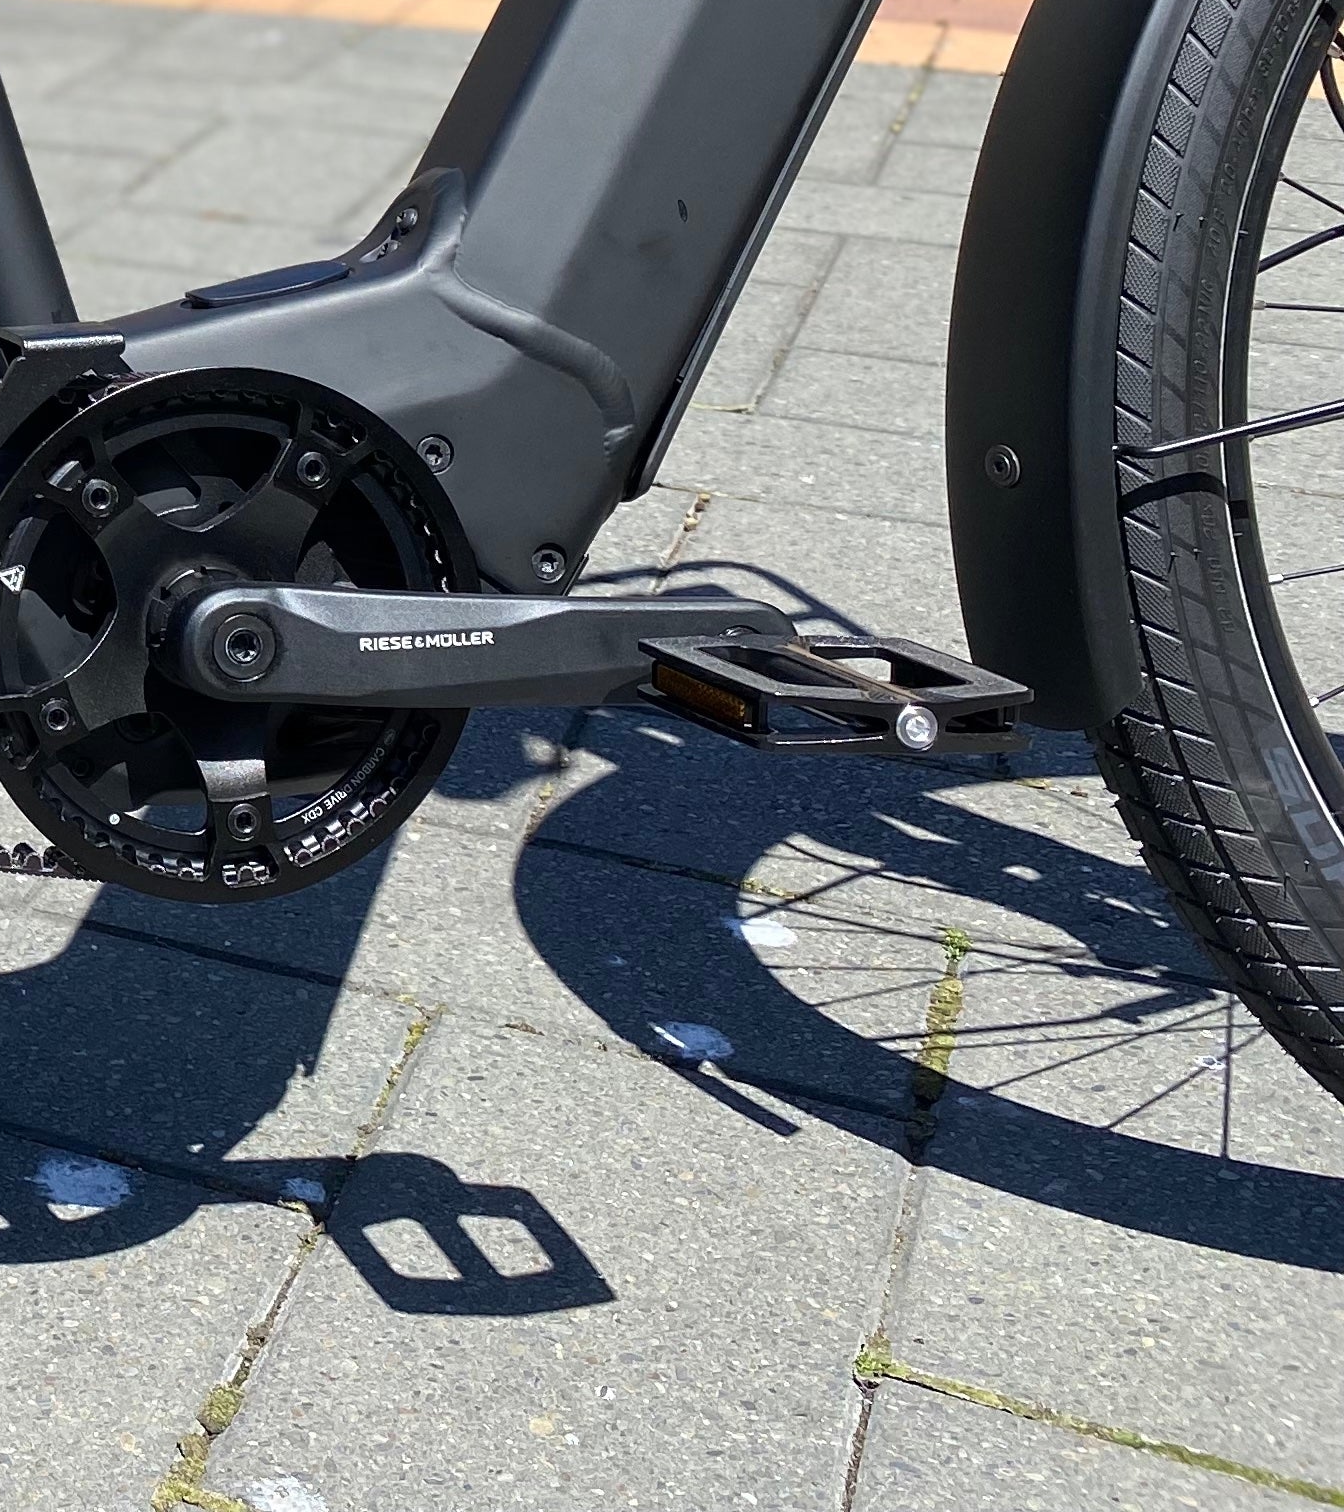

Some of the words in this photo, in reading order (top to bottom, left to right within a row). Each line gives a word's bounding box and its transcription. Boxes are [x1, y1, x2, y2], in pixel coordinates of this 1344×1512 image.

[359, 635, 413, 652] RIESE
[350, 747, 385, 787] CARBON
[323, 783, 352, 810] DRIVE
[300, 805, 324, 824] CDX
